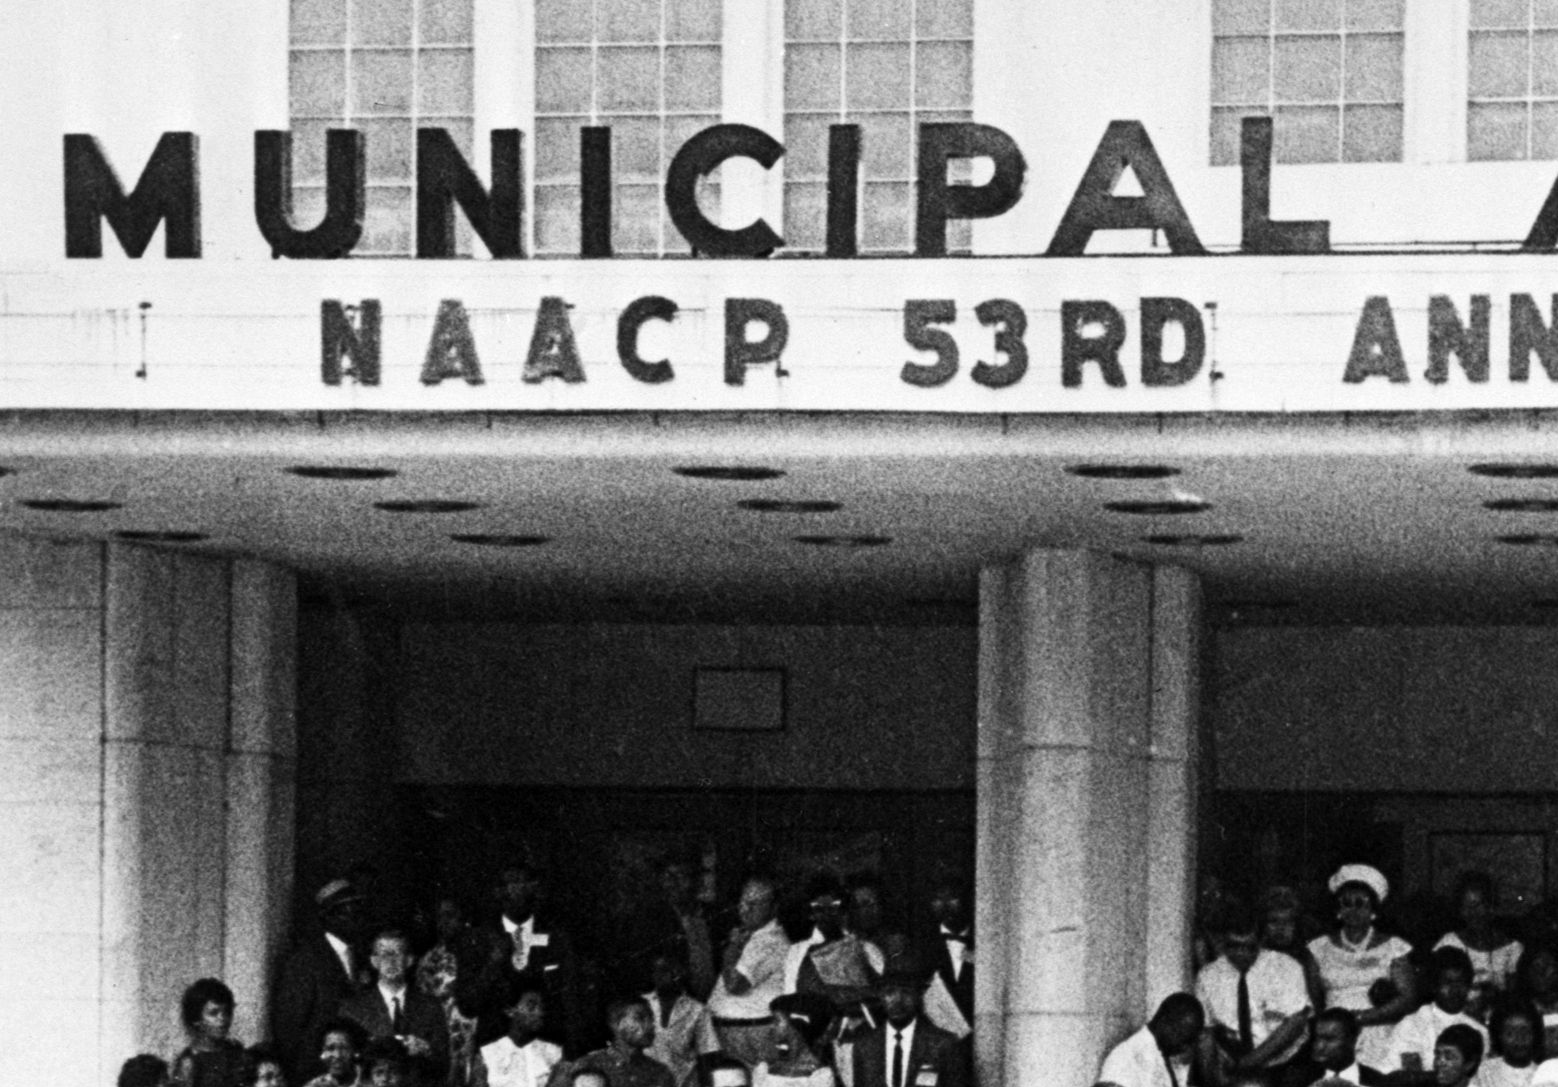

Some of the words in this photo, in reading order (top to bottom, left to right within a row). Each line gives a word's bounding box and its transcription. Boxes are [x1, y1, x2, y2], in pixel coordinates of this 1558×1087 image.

[63, 116, 1331, 259] MUNICIPAL
[321, 296, 790, 386] NAACP
[900, 296, 1207, 387] 53RD
